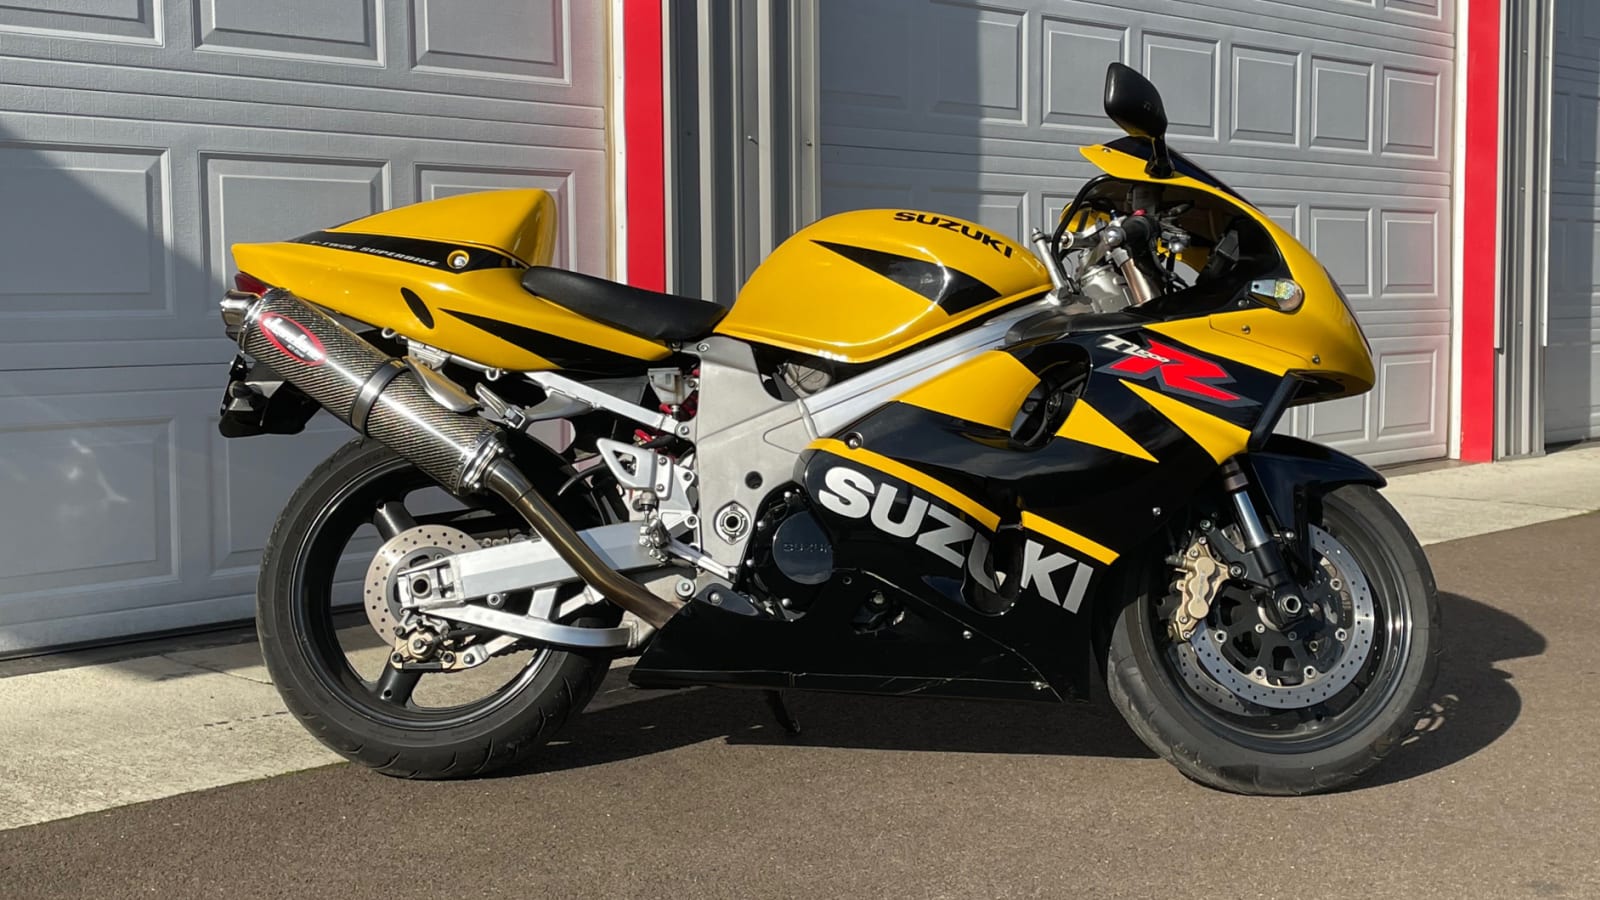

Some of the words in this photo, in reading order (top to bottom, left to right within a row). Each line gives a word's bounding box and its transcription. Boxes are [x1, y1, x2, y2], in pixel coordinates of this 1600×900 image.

[893, 211, 1013, 259] SUZUKI
[359, 246, 441, 267] SUPERBIKE
[783, 542, 833, 554] SUZUK
